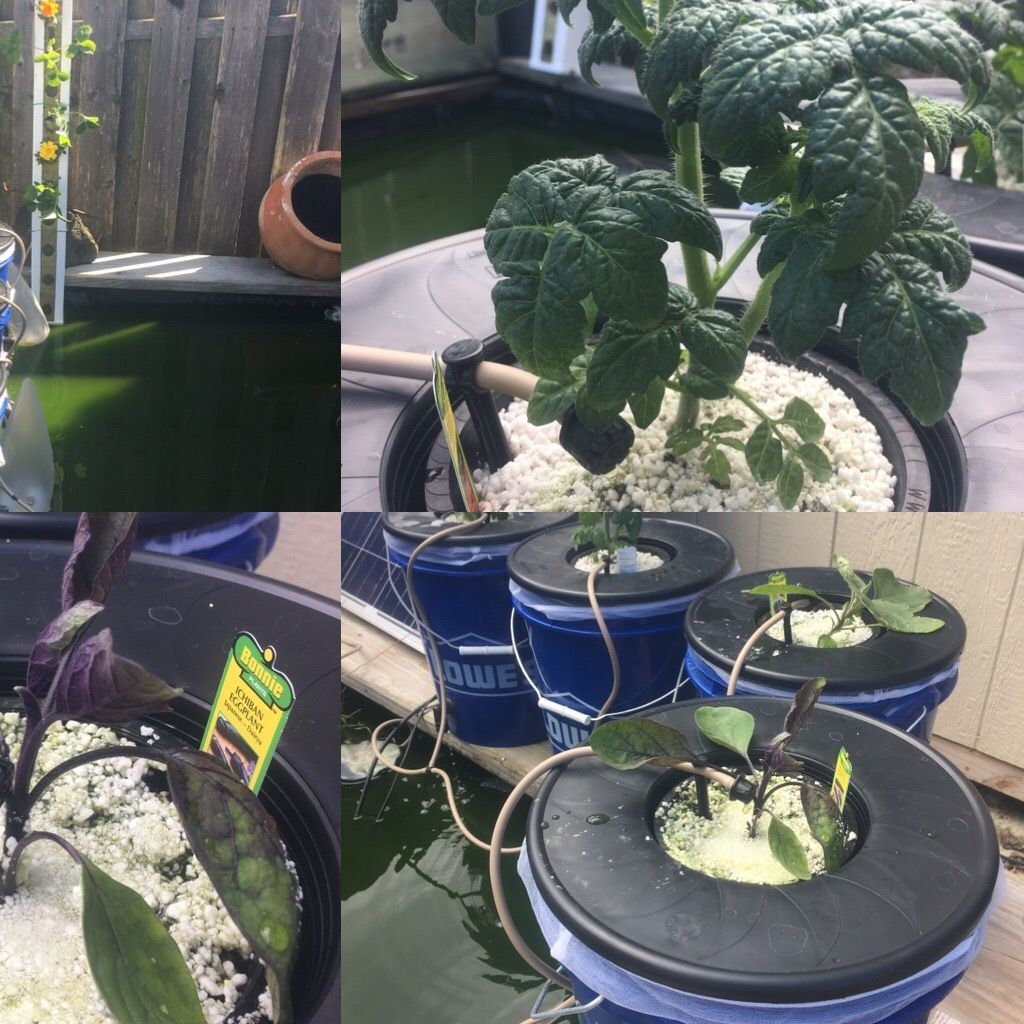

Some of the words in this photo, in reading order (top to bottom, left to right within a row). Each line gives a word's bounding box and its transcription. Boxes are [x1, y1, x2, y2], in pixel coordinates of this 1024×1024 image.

[240, 646, 284, 699] Bonnie
[248, 676, 267, 698] PLANTS
[229, 692, 264, 734] EGGPLANT
[235, 686, 264, 721] ICHIBAN
